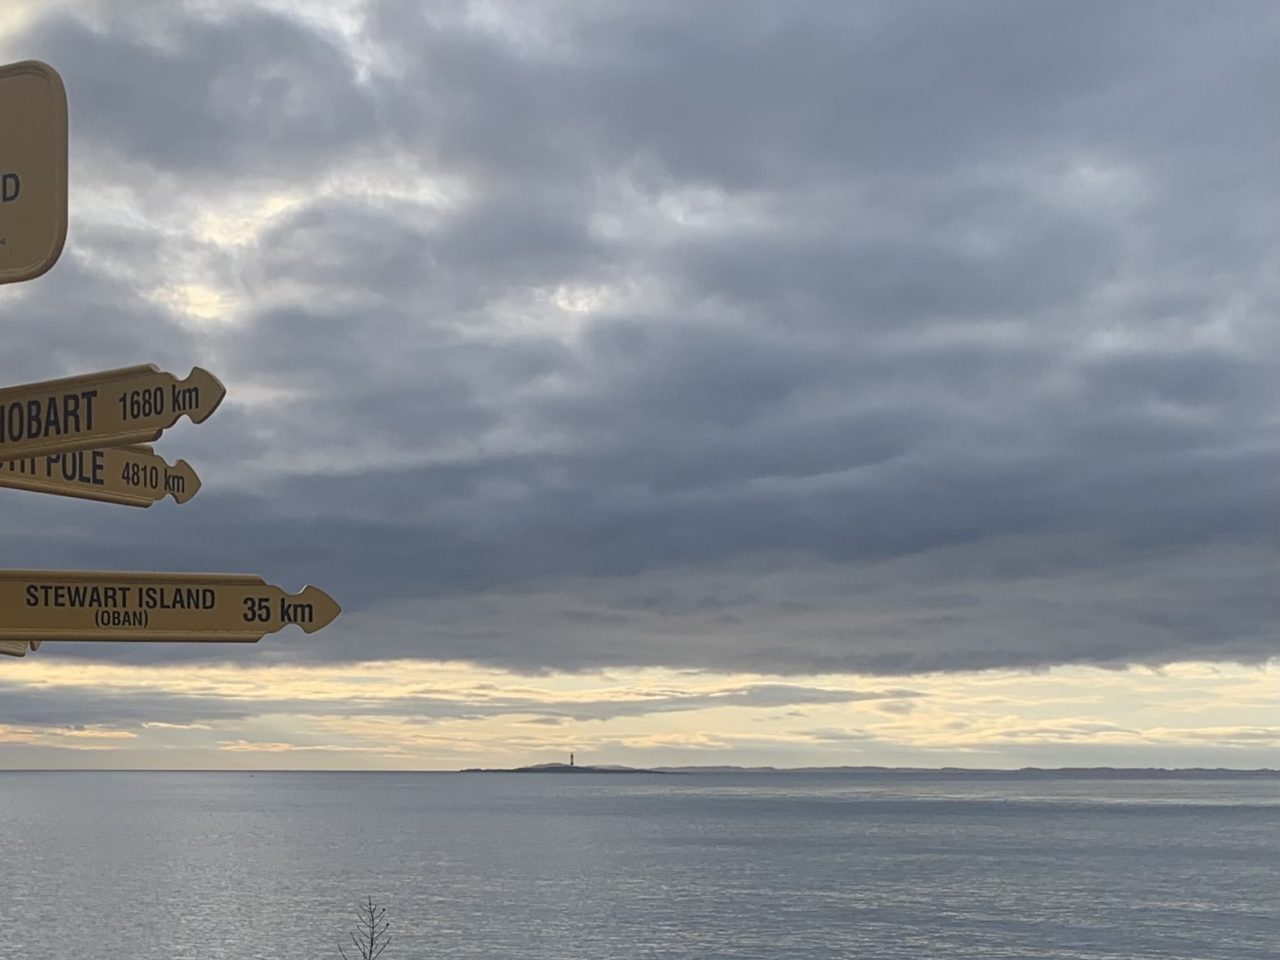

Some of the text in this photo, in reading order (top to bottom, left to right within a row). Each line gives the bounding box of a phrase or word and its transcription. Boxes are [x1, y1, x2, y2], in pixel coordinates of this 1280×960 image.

[119, 386, 165, 421] 1680
[171, 384, 200, 413] km
[46, 450, 105, 486] POLE
[121, 464, 159, 490] 4810
[164, 467, 186, 494] km
[25, 585, 314, 624] STEWART ISLAND 35 km
[94, 609, 150, 629] (OBAN)
